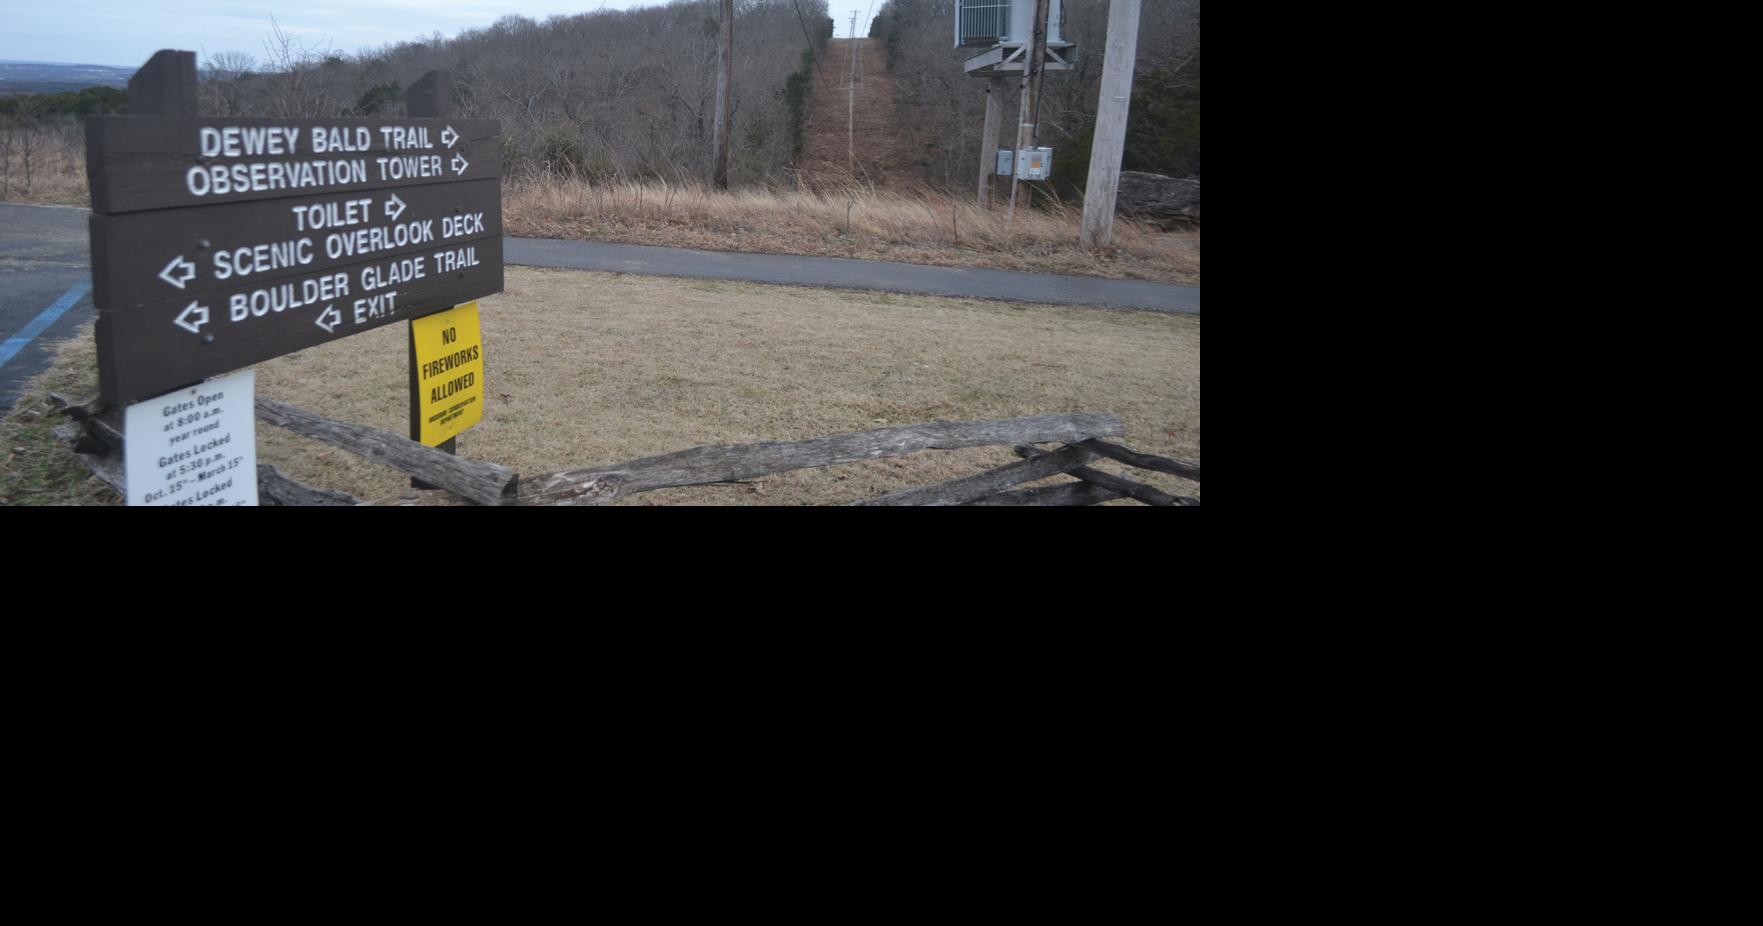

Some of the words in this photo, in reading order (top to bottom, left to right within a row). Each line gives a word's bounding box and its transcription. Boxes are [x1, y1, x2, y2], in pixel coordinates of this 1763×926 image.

[200, 127, 299, 157] DEWEY
[312, 126, 371, 153] BALD
[380, 126, 433, 151] TRAIL
[187, 159, 366, 196] OBSERVATION
[377, 155, 442, 180] TOWER
[293, 199, 372, 231] TOILET
[214, 238, 314, 279] SCENIC
[326, 219, 433, 259] OVERLOOK
[443, 212, 484, 236] DECK
[230, 272, 348, 322] BOULDER
[361, 256, 425, 290] GLADE
[434, 247, 479, 273] TRAIL
[354, 292, 397, 324] EXIT
[442, 327, 457, 345] NO
[423, 345, 479, 380] FIREWORKS
[431, 372, 474, 404] ALLOWED
[163, 402, 194, 417] Gates
[197, 392, 224, 406] Open
[163, 422, 174, 432] at
[177, 412, 201, 427] 8:00
[204, 407, 223, 418] a.m.
[169, 432, 190, 446] year
[193, 420, 220, 435] round
[158, 450, 191, 467] Gates
[194, 433, 231, 454] Locked
[166, 470, 177, 480] at
[180, 459, 203, 474] 5:30
[206, 453, 225, 466] p.m.
[144, 489, 168, 503] Oct.
[199, 464, 226, 482] March
[196, 478, 232, 502] Locked
